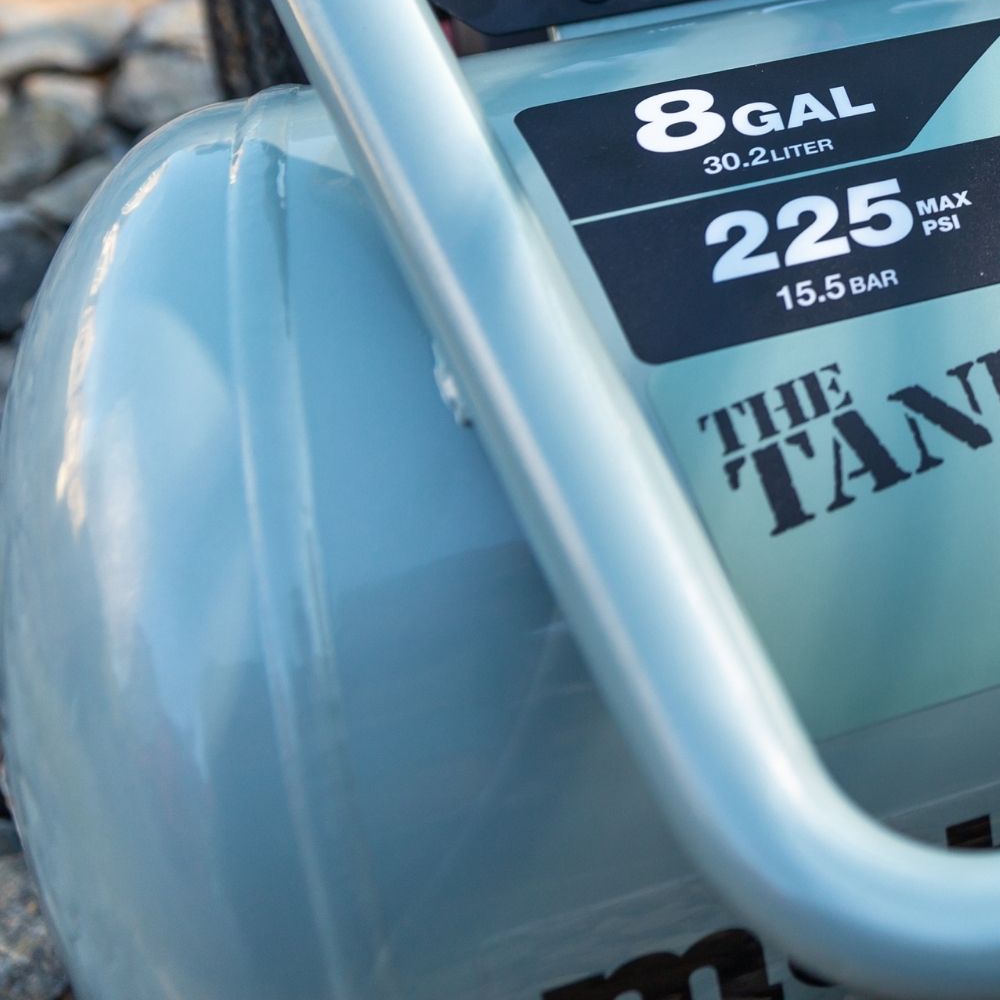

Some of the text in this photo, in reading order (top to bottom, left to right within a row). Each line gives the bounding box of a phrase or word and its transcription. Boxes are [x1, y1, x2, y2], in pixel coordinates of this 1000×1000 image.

[704, 178, 972, 284] 225 MAX
[921, 214, 961, 236] PSI
[775, 269, 899, 310] 15.5 BAR
[698, 362, 853, 457] THE
